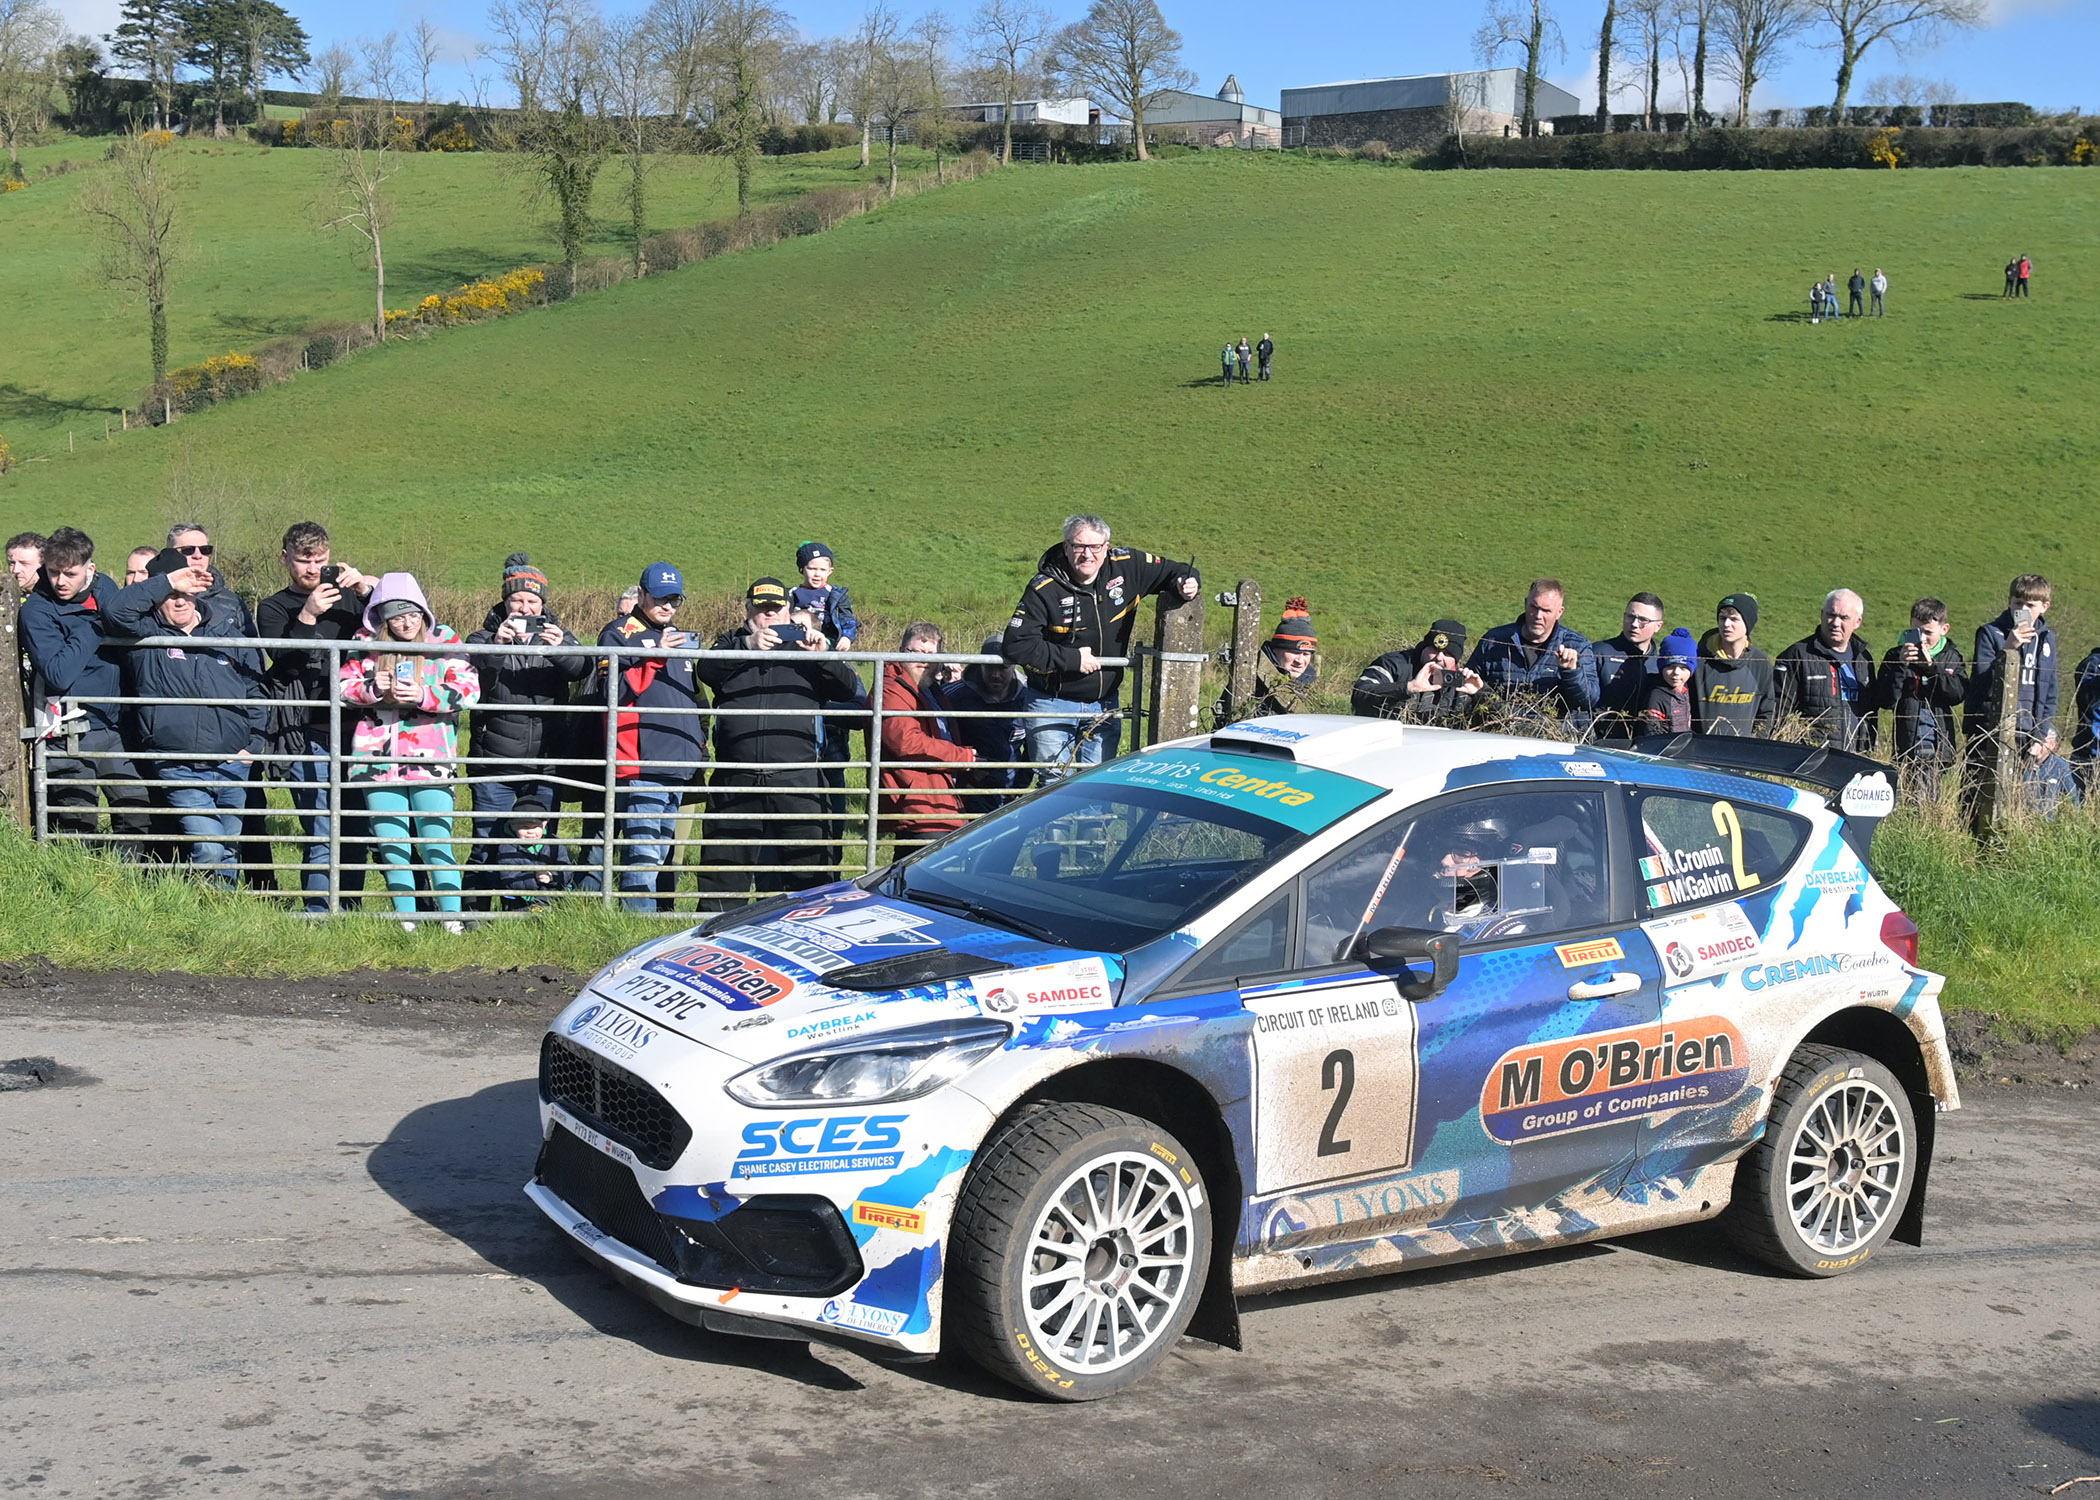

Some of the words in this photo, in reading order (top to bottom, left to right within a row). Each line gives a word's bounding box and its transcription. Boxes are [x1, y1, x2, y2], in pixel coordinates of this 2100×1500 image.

[1106, 759, 1200, 778] Cronin's
[1199, 768, 1315, 807] Centra
[1194, 786, 1217, 795] Union
[1660, 843, 1725, 877] K.Cronin
[1711, 800, 1760, 891] 2
[1667, 869, 1734, 904] M.Galvin
[1806, 871, 1862, 886] DAYBREAK
[1822, 885, 1857, 894] Westlink
[1562, 942, 1618, 963] PIRELLI
[1698, 936, 1755, 960] SAMDEC
[652, 964, 678, 977] Group
[676, 968, 688, 979] of
[686, 972, 736, 1005] Companies
[664, 946, 703, 961] M
[687, 952, 780, 1001] O'Brien
[1741, 953, 1839, 991] CREMIN
[1838, 951, 1889, 973] Coaches
[615, 975, 672, 1001] PY73
[654, 991, 707, 1020] BYC
[1027, 986, 1102, 1003] SAMDEC
[594, 1009, 658, 1048] LYONS
[787, 1011, 877, 1038] DAYBREAK
[807, 1024, 860, 1040] Westlink
[1257, 1011, 1305, 1033] CIRCUIT
[1308, 1008, 1323, 1026] OF
[1327, 1001, 1379, 1023] IRELAND
[583, 1030, 634, 1061] MOTORGROUP
[1500, 1057, 1543, 1110] M
[1560, 1033, 1733, 1095] O'Brien
[1317, 1049, 1355, 1157] 2
[1522, 1109, 1578, 1131] Group
[1583, 1101, 1603, 1118] of
[1607, 1084, 1709, 1113] Companies
[737, 1114, 911, 1159] SCES
[739, 1163, 767, 1175] SHANE
[769, 1162, 797, 1173] CASEY
[798, 1158, 850, 1172] ELECTRICAL
[851, 1155, 895, 1169] SERVICES
[860, 1206, 920, 1229] PIRELLI
[1334, 1178, 1447, 1225] LYONS
[847, 1317, 856, 1325] OF
[859, 1320, 895, 1333] LIMERICK
[850, 1305, 899, 1325] LYONS
